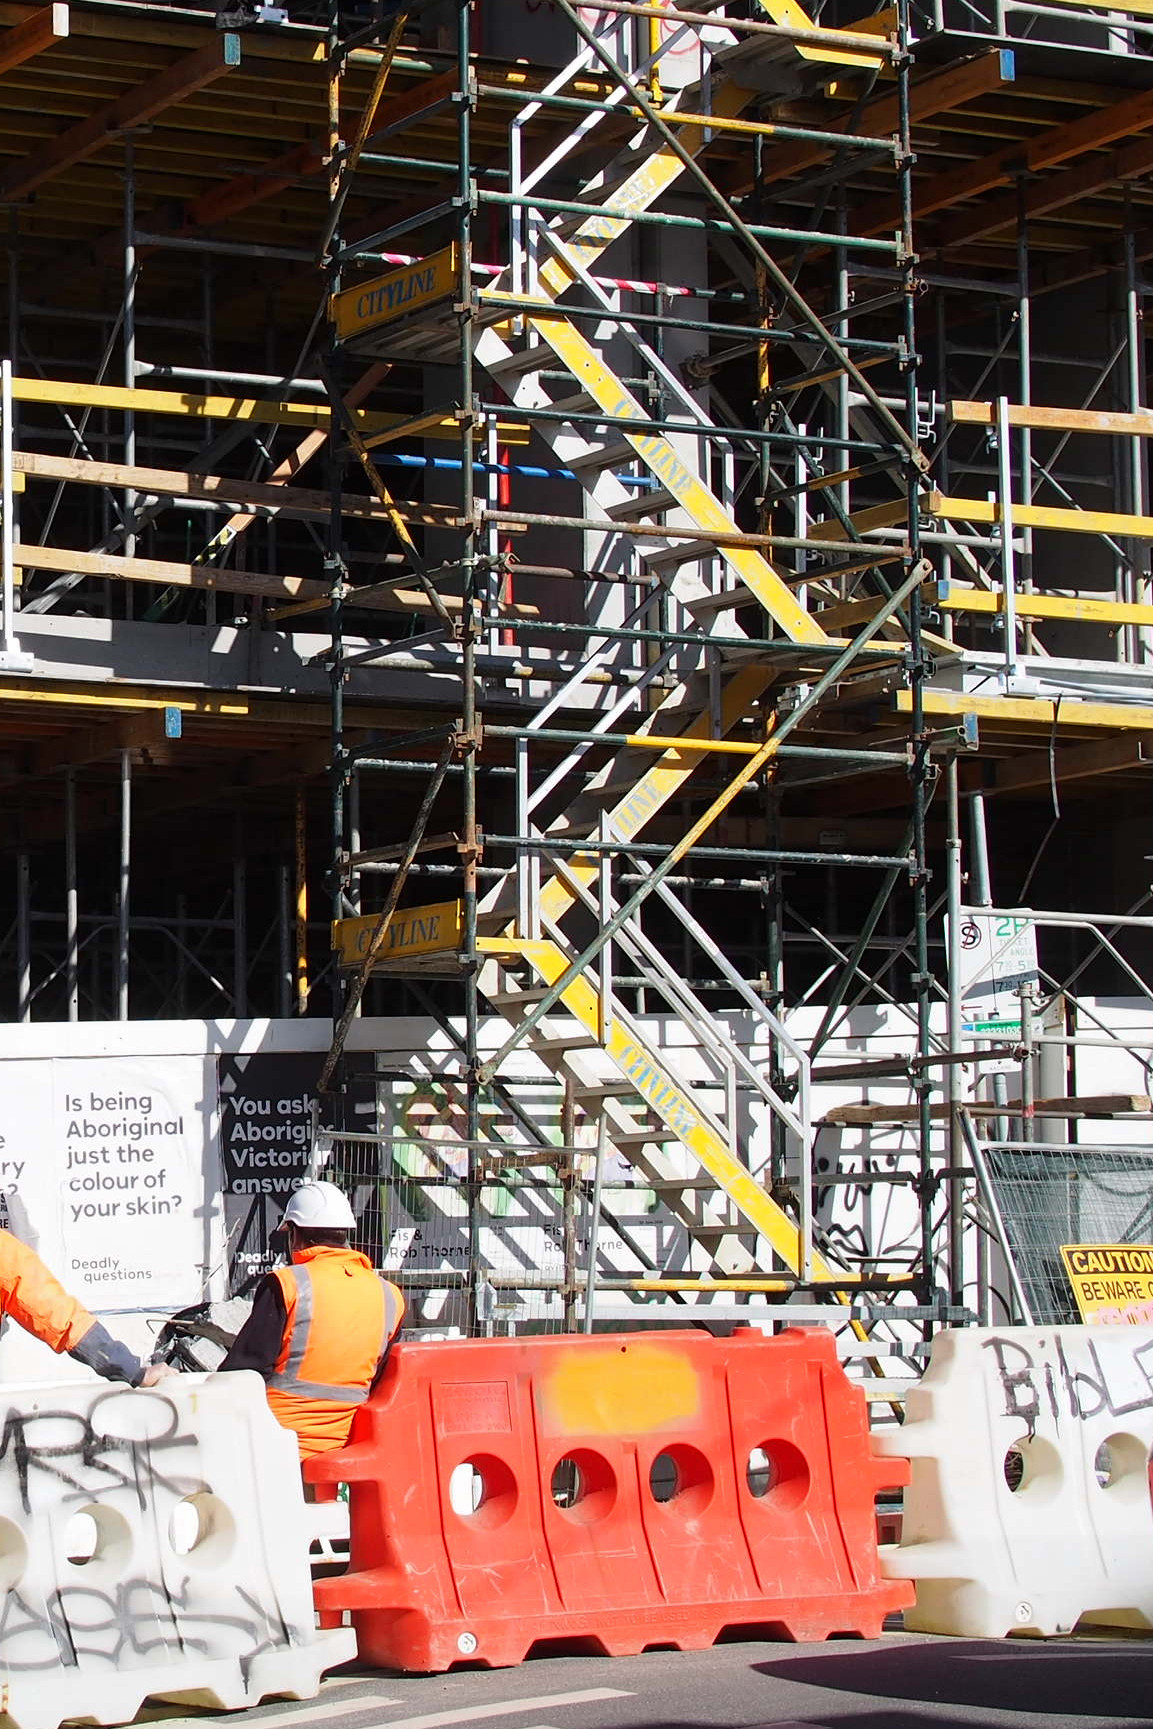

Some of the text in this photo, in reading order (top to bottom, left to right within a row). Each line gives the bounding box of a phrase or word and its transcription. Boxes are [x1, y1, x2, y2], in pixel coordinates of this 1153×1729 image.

[356, 267, 436, 319] CITYLINE
[356, 915, 441, 953] CYLINE
[65, 1092, 153, 1116] Is being
[229, 1097, 271, 1116] You
[67, 1117, 184, 1141] Aboriginal
[230, 1119, 335, 1146] Aborigi
[67, 1145, 155, 1169] just the
[231, 1143, 335, 1168] Victori
[69, 1169, 166, 1192] colour of
[232, 1177, 306, 1195] answe
[70, 1196, 182, 1222] your skin?
[414, 1229, 423, 1241] &
[235, 1249, 282, 1265] Deadly
[390, 1245, 472, 1259] Rob Thorne
[544, 1241, 562, 1252] Ro
[71, 1256, 120, 1270] Deadly
[84, 1270, 152, 1285] questions
[1081, 1280, 1146, 1301] BEWARE
